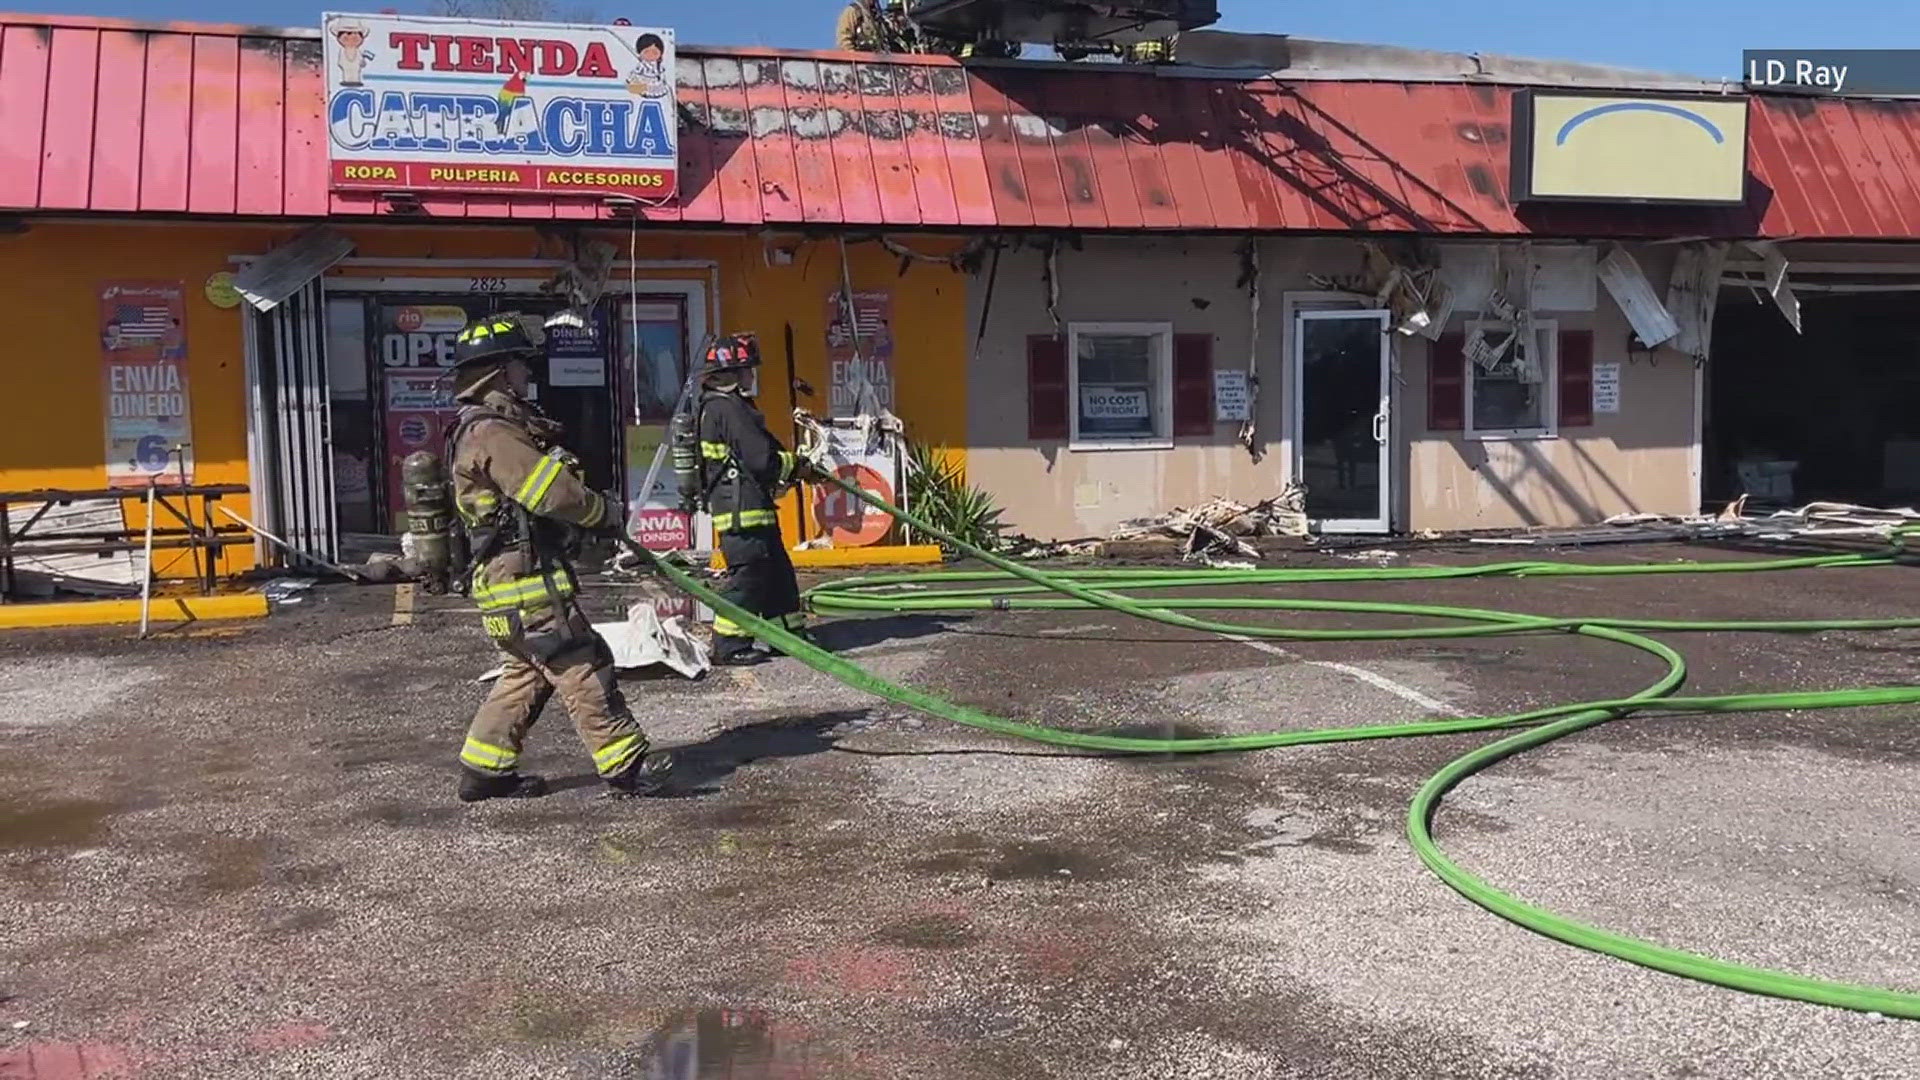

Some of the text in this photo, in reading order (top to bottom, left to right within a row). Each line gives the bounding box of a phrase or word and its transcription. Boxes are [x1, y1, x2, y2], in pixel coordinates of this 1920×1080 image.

[389, 32, 617, 78] TIENDA
[329, 88, 674, 156] CATRACHA
[344, 165, 663, 187] ROPA PULPERIA ACCESORIOS
[470, 277, 506, 291] 2825
[399, 309, 421, 322] ria
[383, 333, 457, 367] OPE
[110, 360, 181, 392] ENVÍA
[110, 393, 184, 416] DINERO
[1089, 396, 1139, 405] NO COST
[642, 531, 686, 543] DINERO
